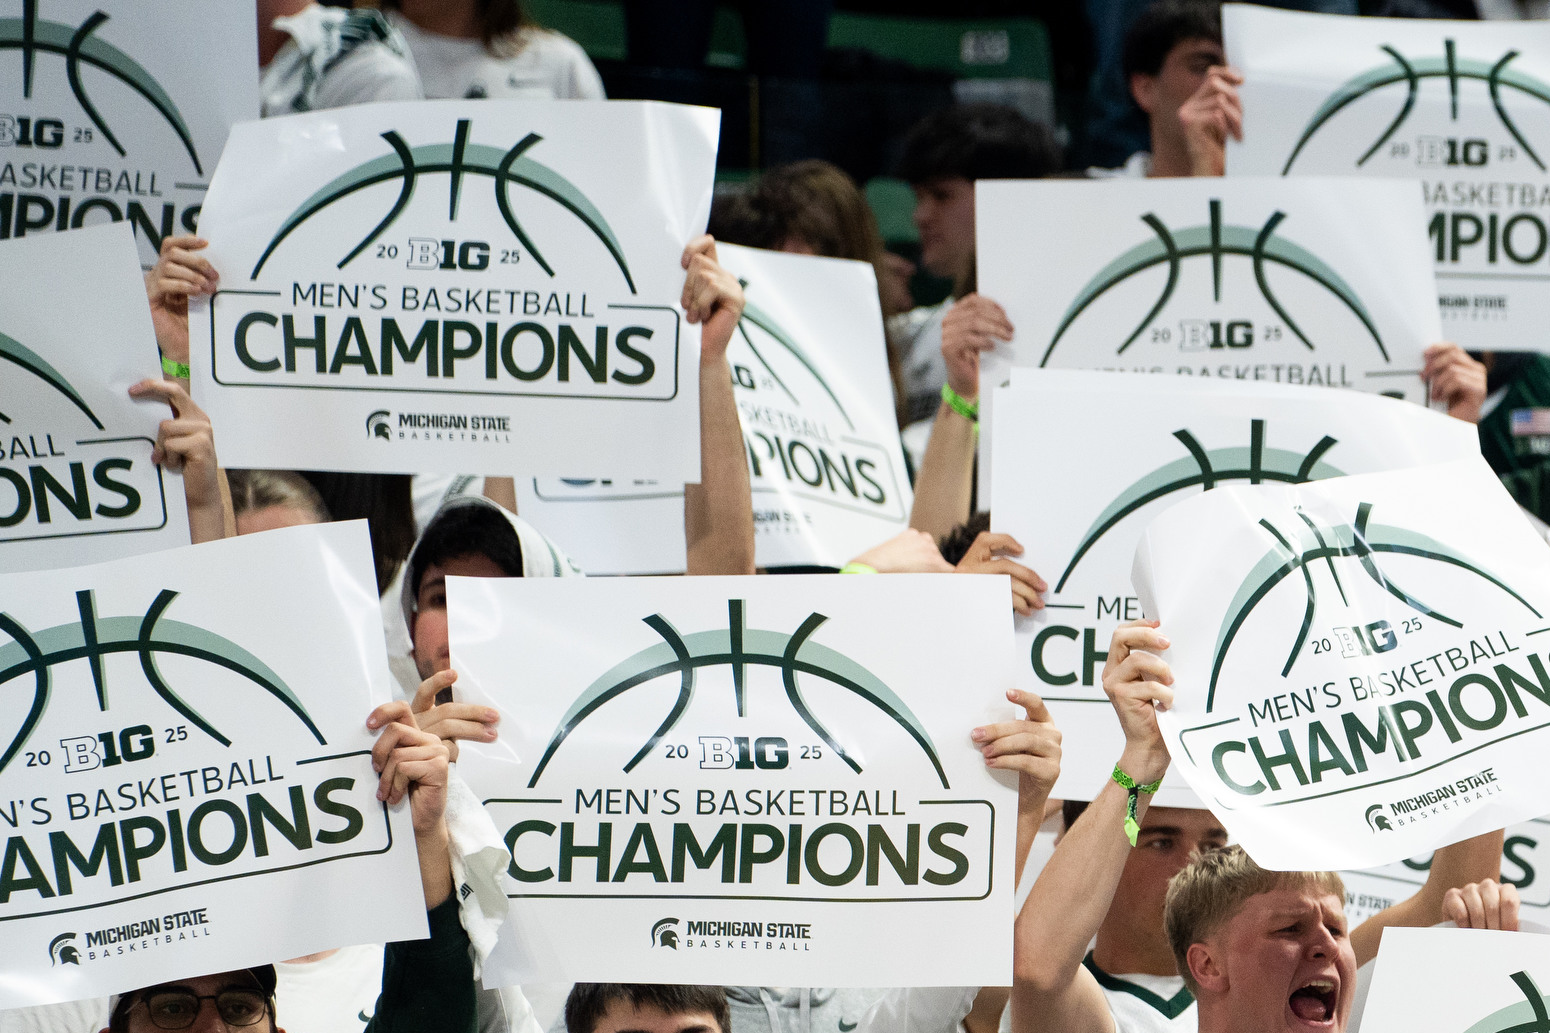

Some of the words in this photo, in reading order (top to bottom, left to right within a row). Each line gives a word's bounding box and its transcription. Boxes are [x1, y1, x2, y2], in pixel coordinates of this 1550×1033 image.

[73, 127, 93, 144] 25
[1390, 143, 1410, 159] 20
[1499, 146, 1517, 161] 25
[377, 244, 398, 260] 20
[500, 249, 521, 265] 25
[292, 281, 388, 309] MEN'S
[401, 287, 594, 318] BASKETBALL
[234, 311, 656, 386] CHAMPIONS
[1151, 328, 1171, 344] 20
[1264, 326, 1283, 341] 25
[399, 413, 467, 430] MICHIGAN
[470, 415, 511, 432] STATE
[399, 430, 511, 444] BASKETBALL
[1312, 639, 1332, 655] 20
[1403, 617, 1423, 635] 25
[1248, 681, 1342, 728] MEN'S
[1349, 630, 1521, 702] BASKETBALL
[25, 750, 52, 768] 20
[164, 725, 189, 744] 25
[665, 743, 689, 760] 20
[800, 744, 823, 760] 25
[67, 755, 285, 821] BASKETBALL
[575, 788, 681, 815] MEN'S
[697, 788, 906, 816] BASKETBALL
[1391, 785, 1457, 817] MICHIGAN
[1455, 767, 1499, 796] STATE
[1397, 784, 1504, 826] BASKETBALL
[505, 819, 970, 887] CHAMPIONS
[85, 917, 161, 948] MICHIGAN
[164, 906, 210, 931] STATE
[88, 926, 211, 961] BASKETBALL
[686, 920, 764, 938] MICHIGAN
[766, 921, 813, 940] STATE
[686, 939, 811, 951] BASKETBALL
